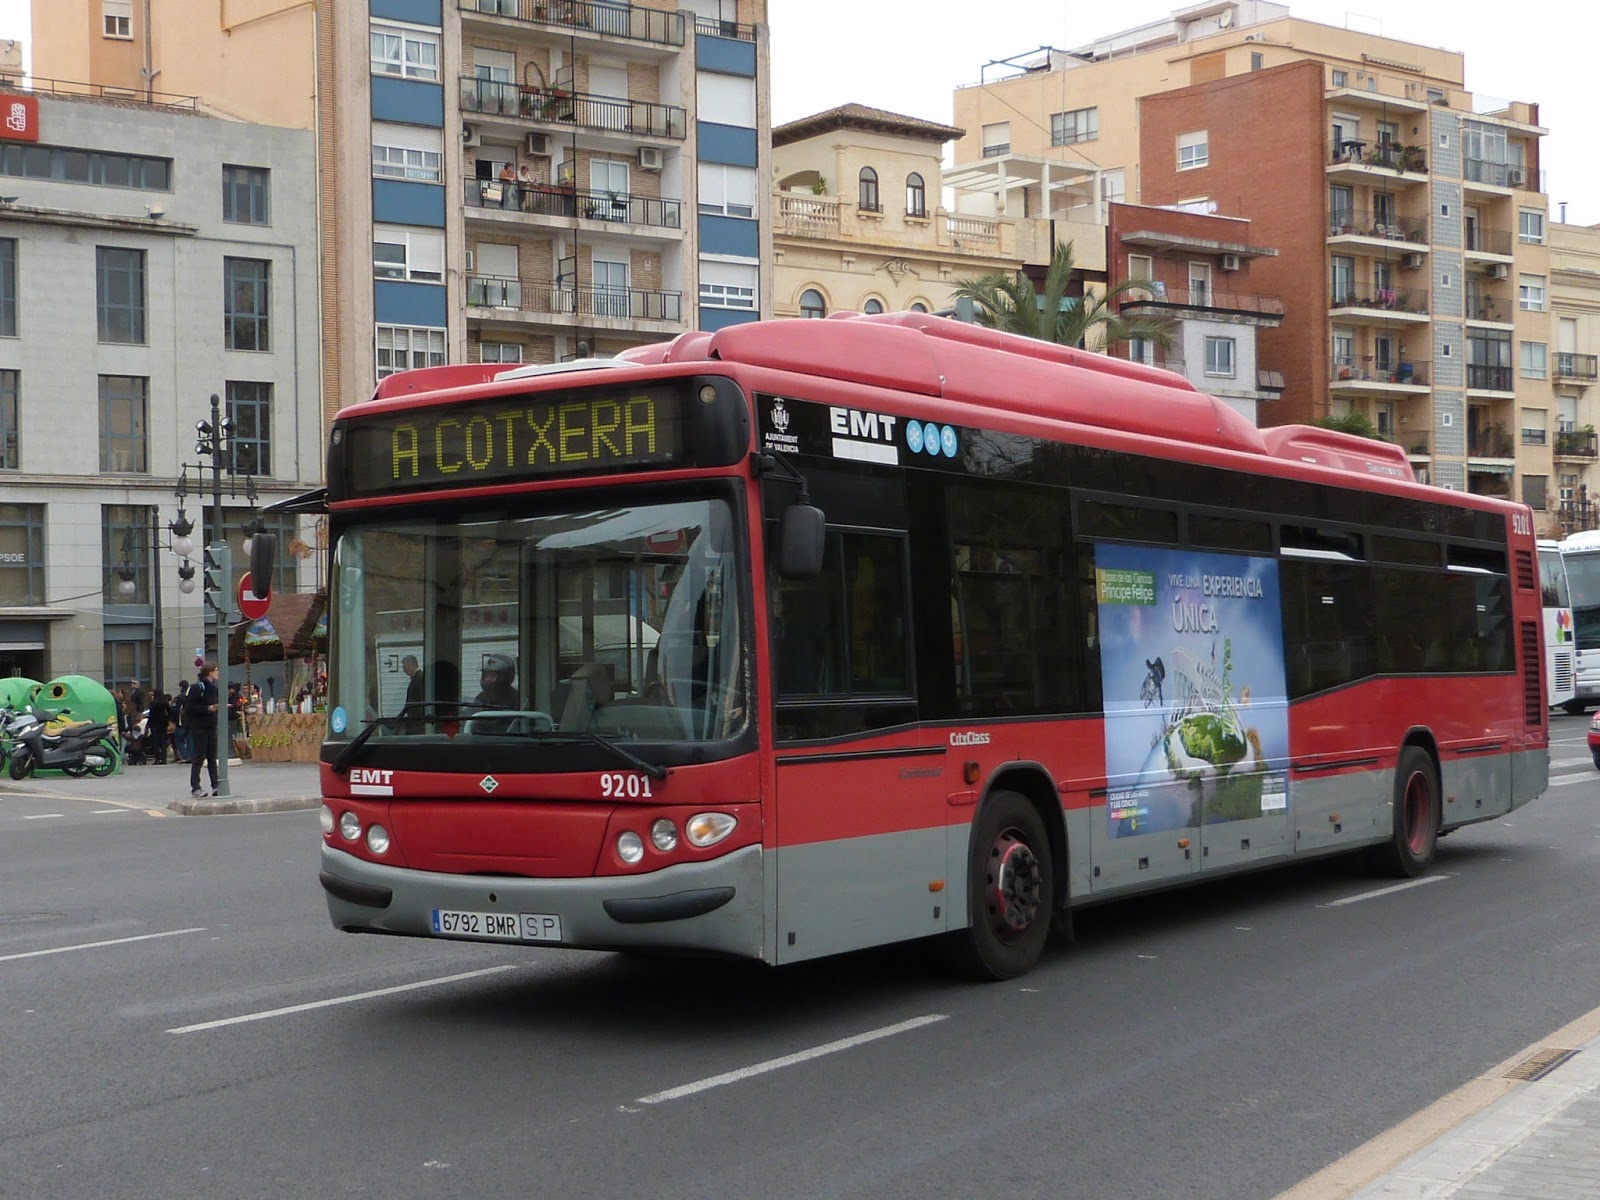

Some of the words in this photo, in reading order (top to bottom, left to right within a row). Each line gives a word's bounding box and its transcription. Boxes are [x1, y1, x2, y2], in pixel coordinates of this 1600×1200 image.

[830, 406, 896, 441] EMT
[392, 423, 419, 479] A
[435, 395, 655, 474] COTXERA
[765, 432, 799, 444] AJUNTAMENT
[774, 443, 799, 453] VALENCIA
[1512, 513, 1531, 535] 9201
[1100, 570, 1117, 583] Museo
[1168, 573, 1184, 588] VIVE
[1185, 576, 1200, 589] UNA
[1202, 574, 1264, 598] EXPERIENCIA
[1101, 582, 1131, 604] Príncipe
[1132, 584, 1154, 604] Felipe
[1172, 593, 1220, 633] ÚNICA
[350, 769, 394, 784] EMT
[600, 773, 652, 798] 9201
[442, 912, 480, 933] 6792
[485, 915, 516, 936] BMR
[526, 917, 555, 937] SP
